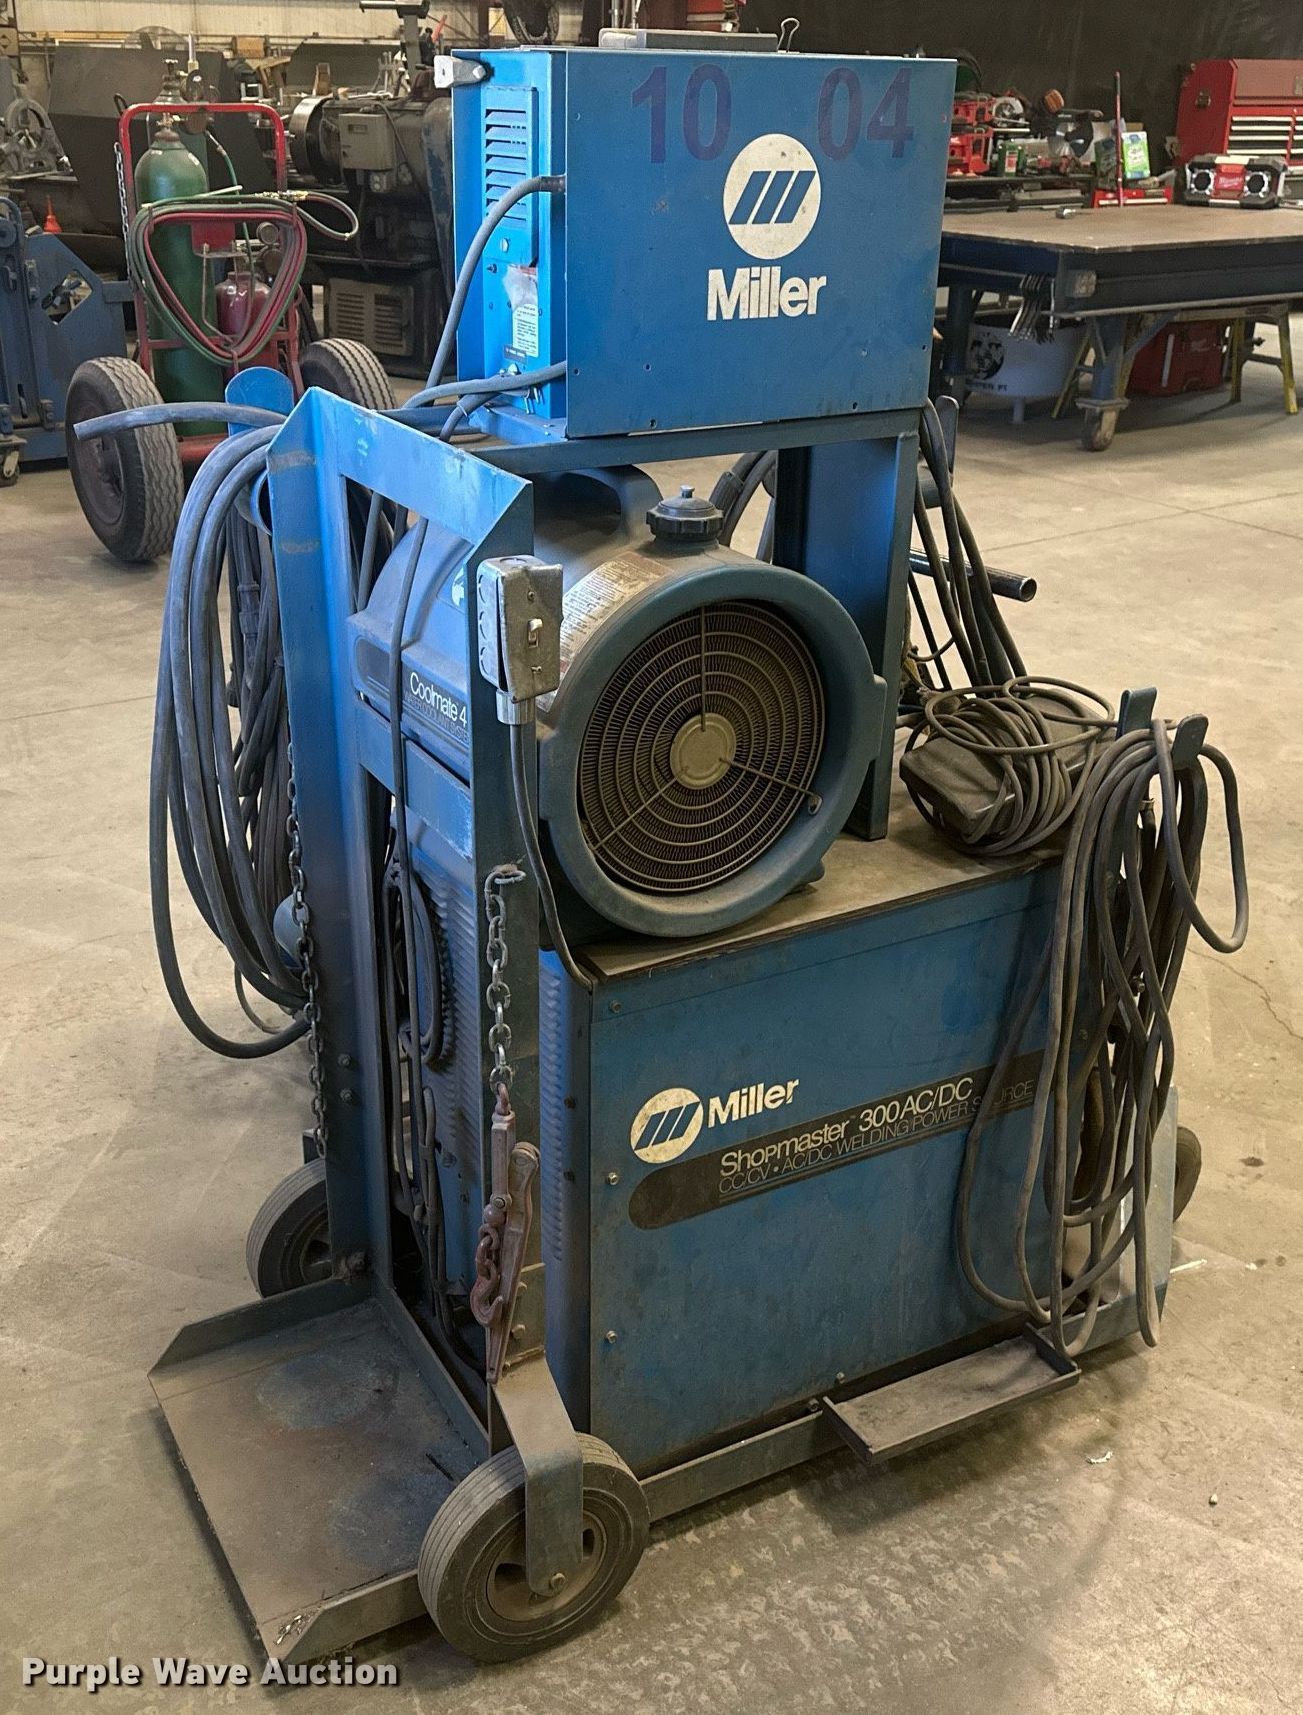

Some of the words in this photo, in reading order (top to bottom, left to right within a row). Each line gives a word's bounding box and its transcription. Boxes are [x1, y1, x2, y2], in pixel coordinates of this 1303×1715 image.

[707, 266, 827, 321] Miller
[410, 672, 457, 721] Coolmate
[459, 706, 467, 727] 4
[708, 1079, 799, 1128] Miller
[719, 1164, 771, 1194] CC/CV
[782, 1144, 833, 1175] AC/DC
[836, 1120, 910, 1156] WELDING
[912, 1101, 969, 1132] POWER
[720, 1121, 849, 1177] Shopmaster
